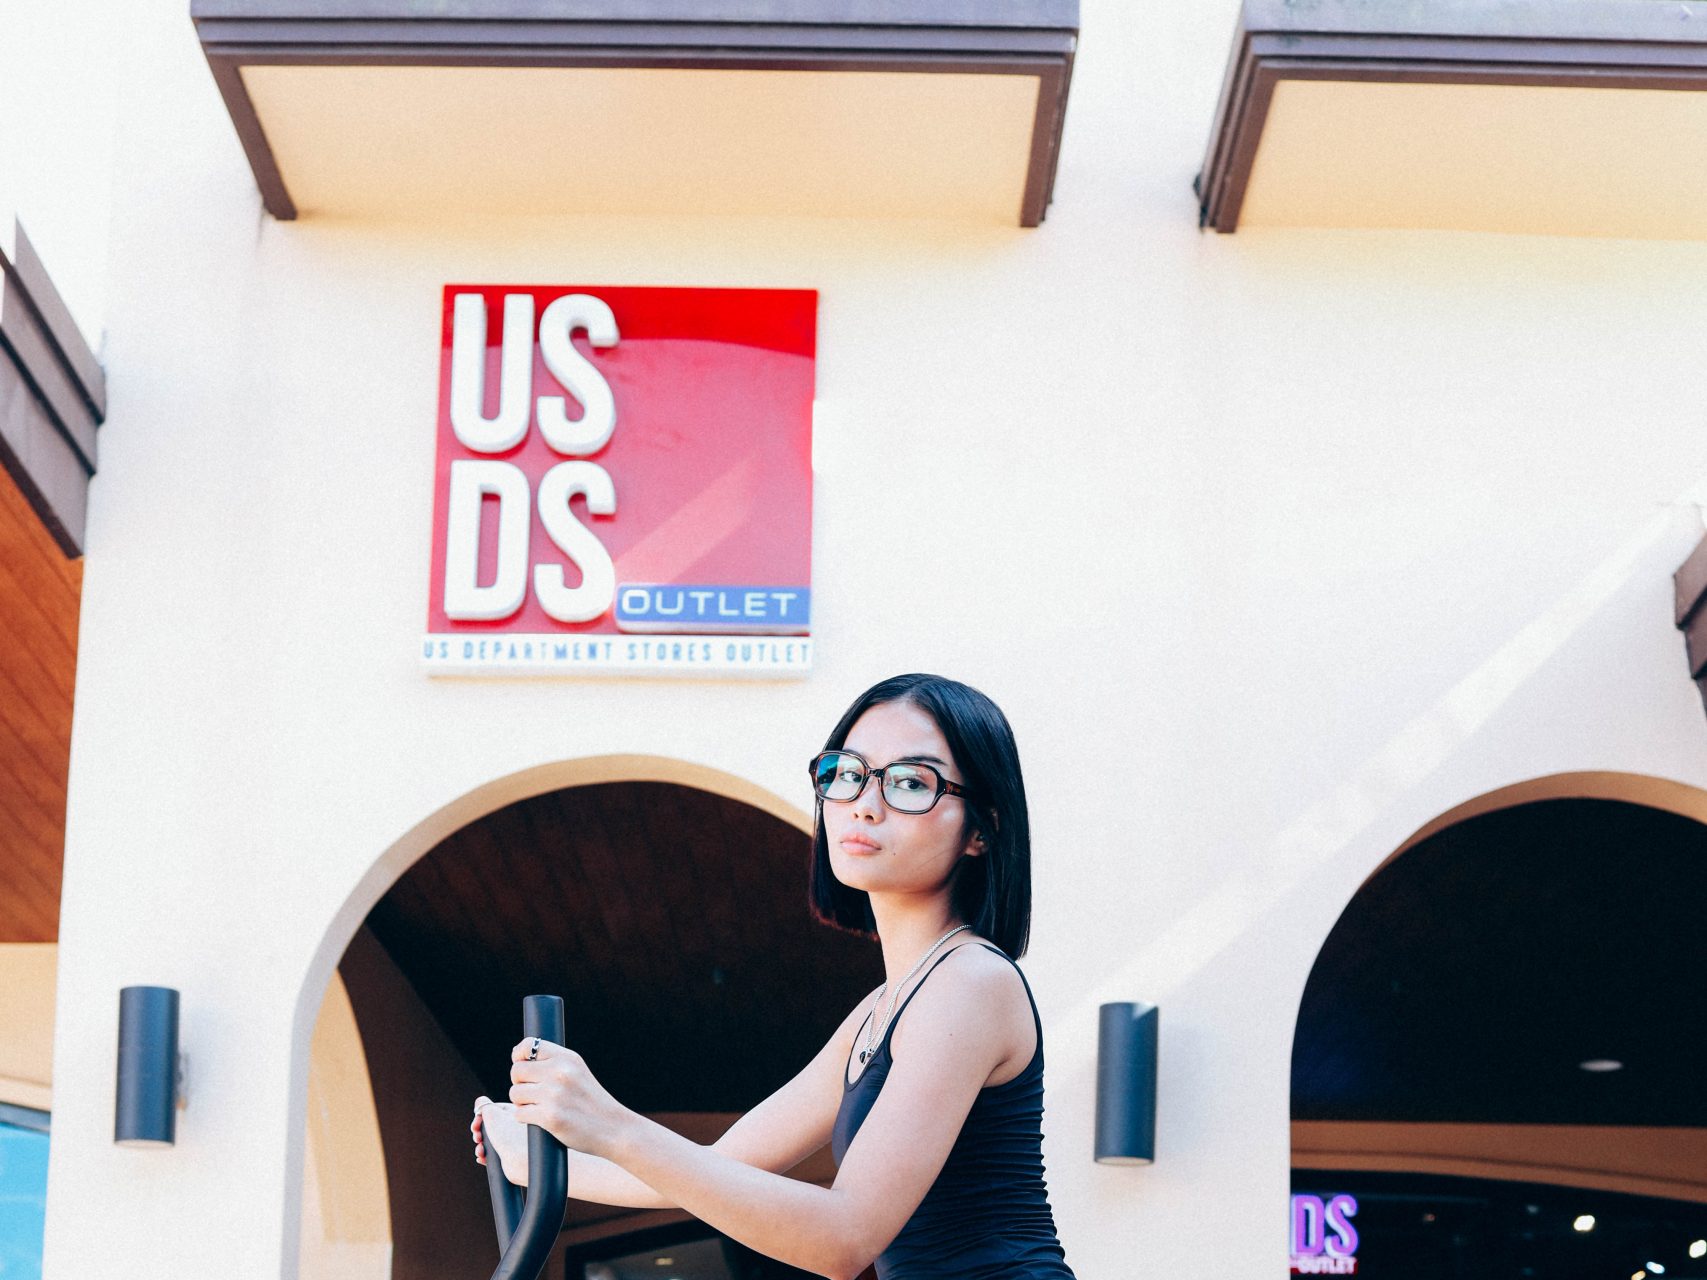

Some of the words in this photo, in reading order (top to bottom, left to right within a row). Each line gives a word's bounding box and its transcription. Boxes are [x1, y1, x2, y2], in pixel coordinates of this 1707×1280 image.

[450, 293, 620, 455] US
[443, 459, 616, 623] DS
[621, 588, 798, 617] OUTLET
[423, 640, 449, 660] US
[463, 641, 612, 661] DEPARTMENT
[627, 642, 712, 662] STORES
[725, 642, 810, 664] OUTLET
